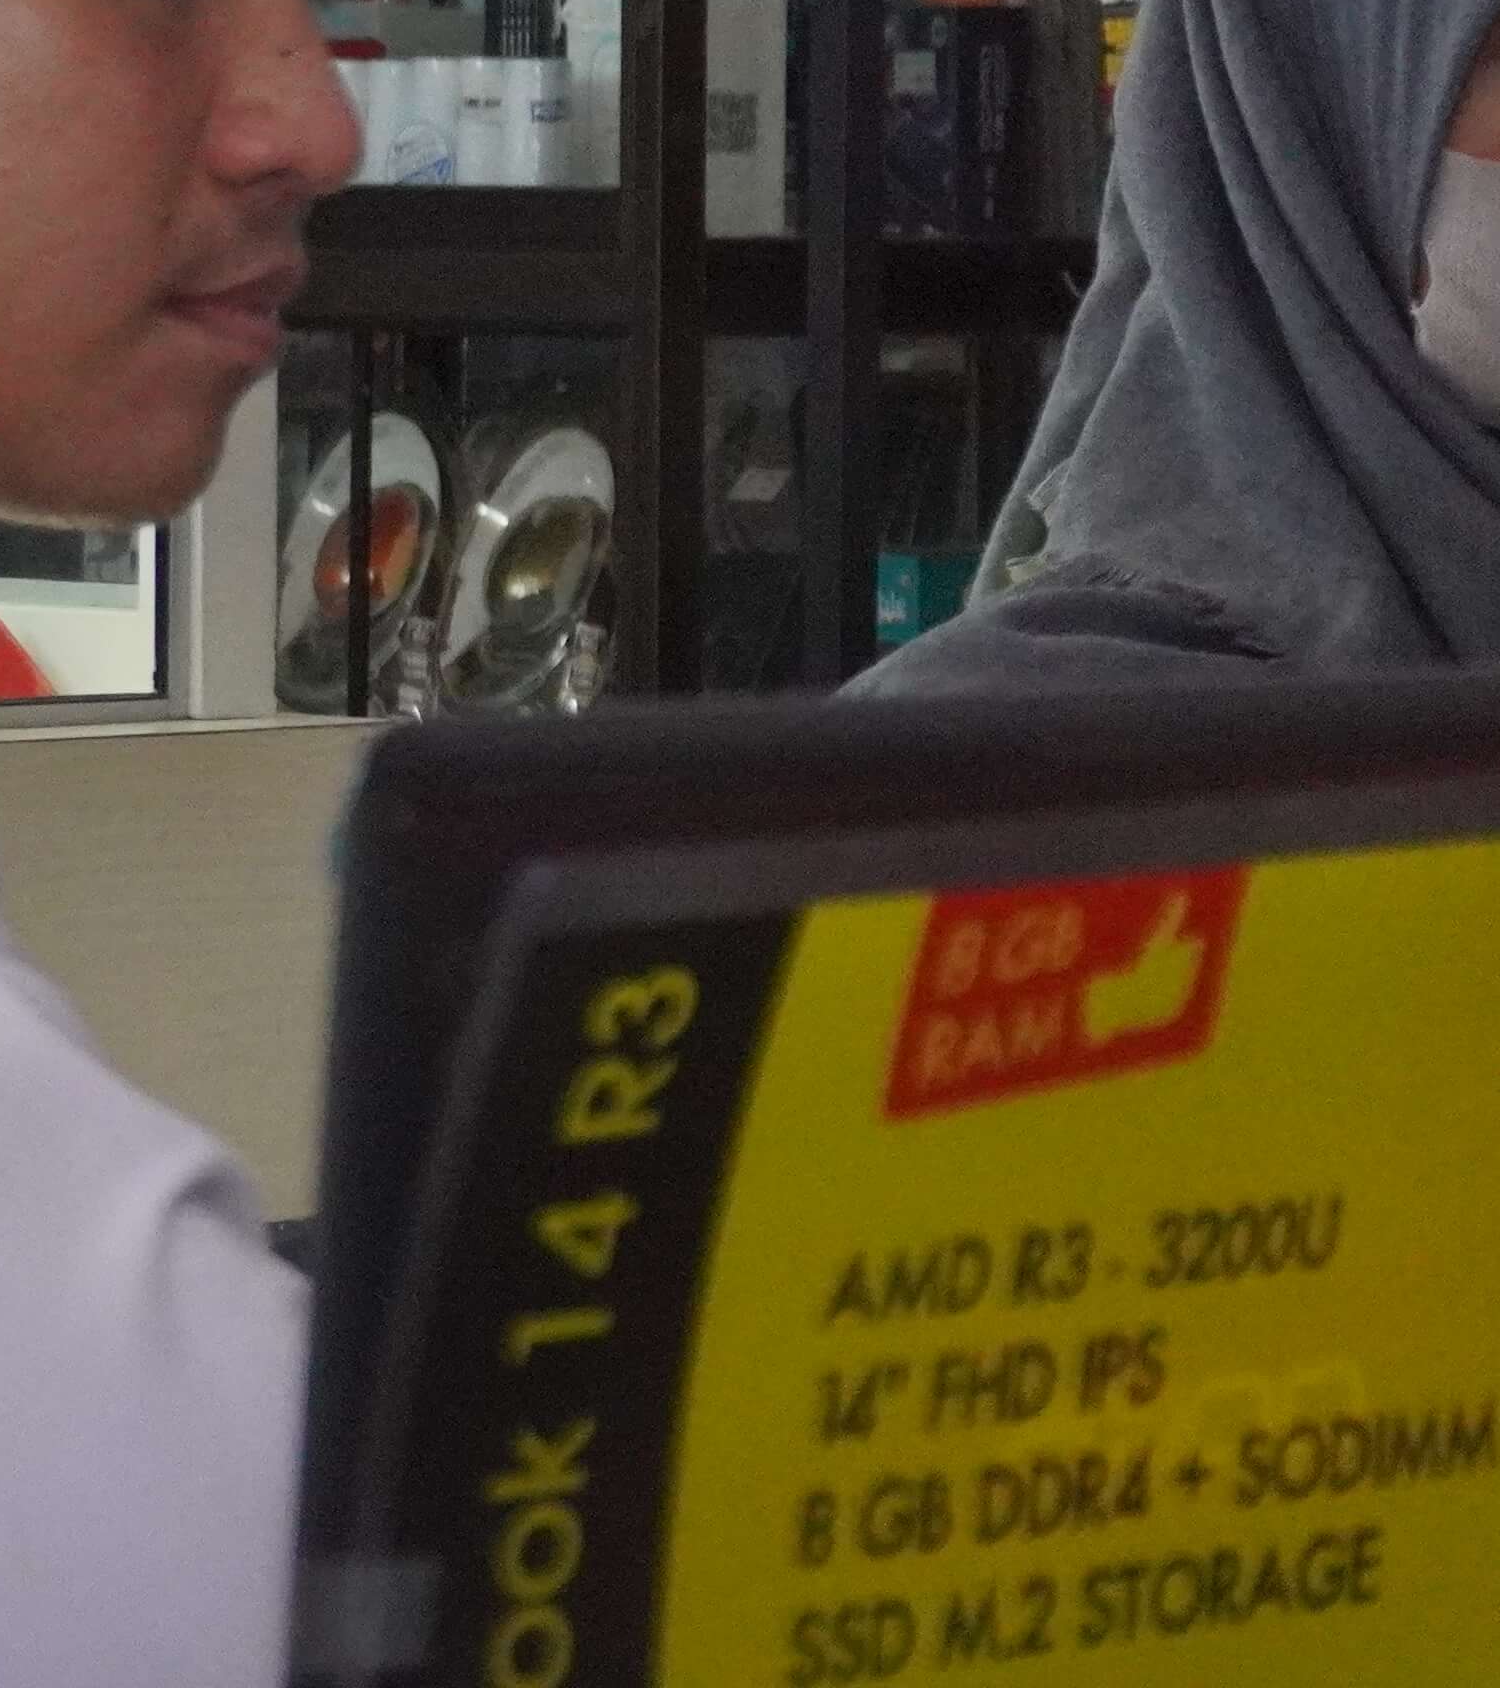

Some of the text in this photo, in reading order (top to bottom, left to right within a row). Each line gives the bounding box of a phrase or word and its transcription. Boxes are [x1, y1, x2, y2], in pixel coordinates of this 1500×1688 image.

[938, 902, 1084, 997] 8 GB
[556, 964, 698, 1147] R3
[916, 995, 1068, 1092] RAM
[826, 1232, 994, 1326] AMD
[1011, 1222, 1095, 1304] R3
[1143, 1192, 1346, 1288] 3200U
[923, 1340, 1056, 1429] FHD
[1078, 1324, 1169, 1411] IPS
[797, 1488, 837, 1568] 8
[855, 1472, 953, 1559] GB
[971, 1446, 1154, 1544] DDR4
[1178, 1452, 1210, 1496] +
[1233, 1404, 1496, 1505] SODIMM
[786, 1524, 1384, 1688] SSD M.2 STORAGE
